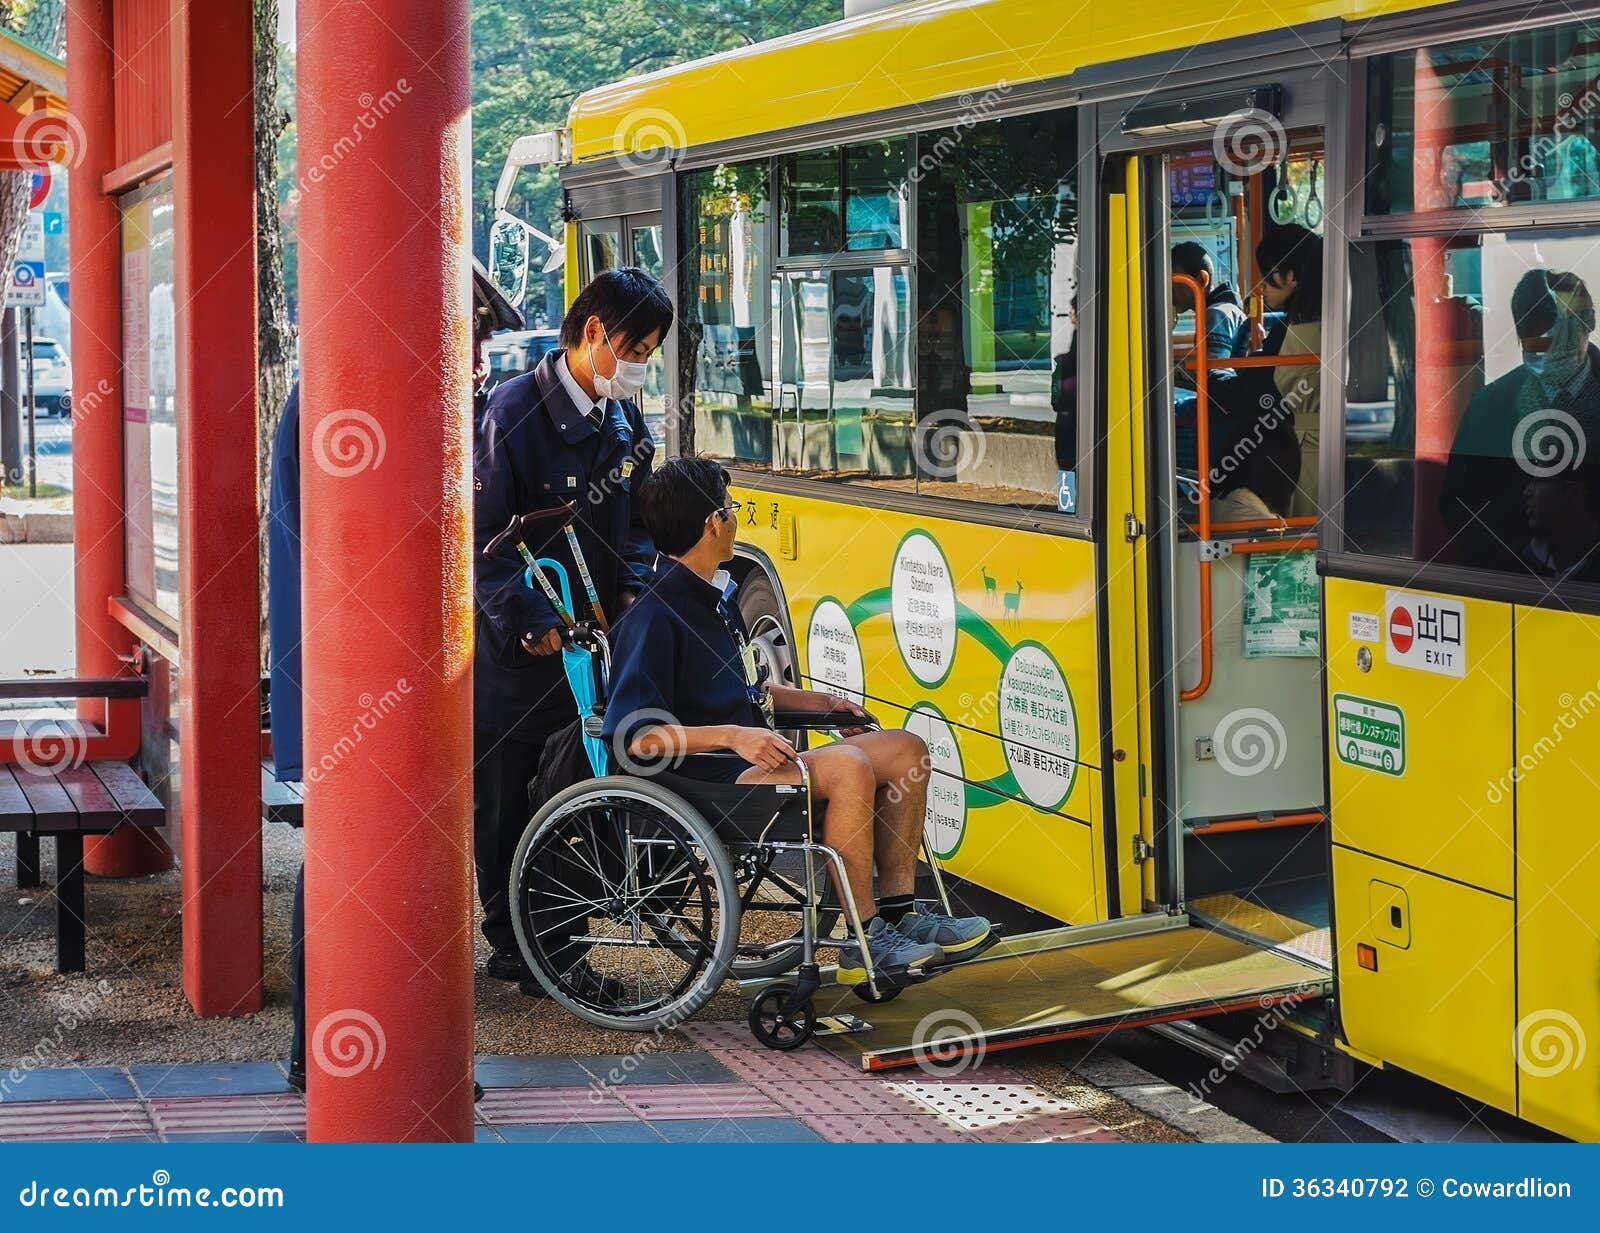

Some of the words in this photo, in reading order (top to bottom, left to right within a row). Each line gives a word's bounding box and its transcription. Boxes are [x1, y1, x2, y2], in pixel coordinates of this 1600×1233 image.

[900, 557, 927, 575] Kintetsu
[928, 562, 944, 578] Nara
[911, 575, 934, 594] Station
[813, 623, 820, 636] JR
[820, 625, 834, 640] Nara
[833, 628, 855, 647] Station
[1417, 603, 1462, 646] 出口
[1425, 650, 1453, 667] EXIT
[1033, 751, 1071, 780] 春日大社前
